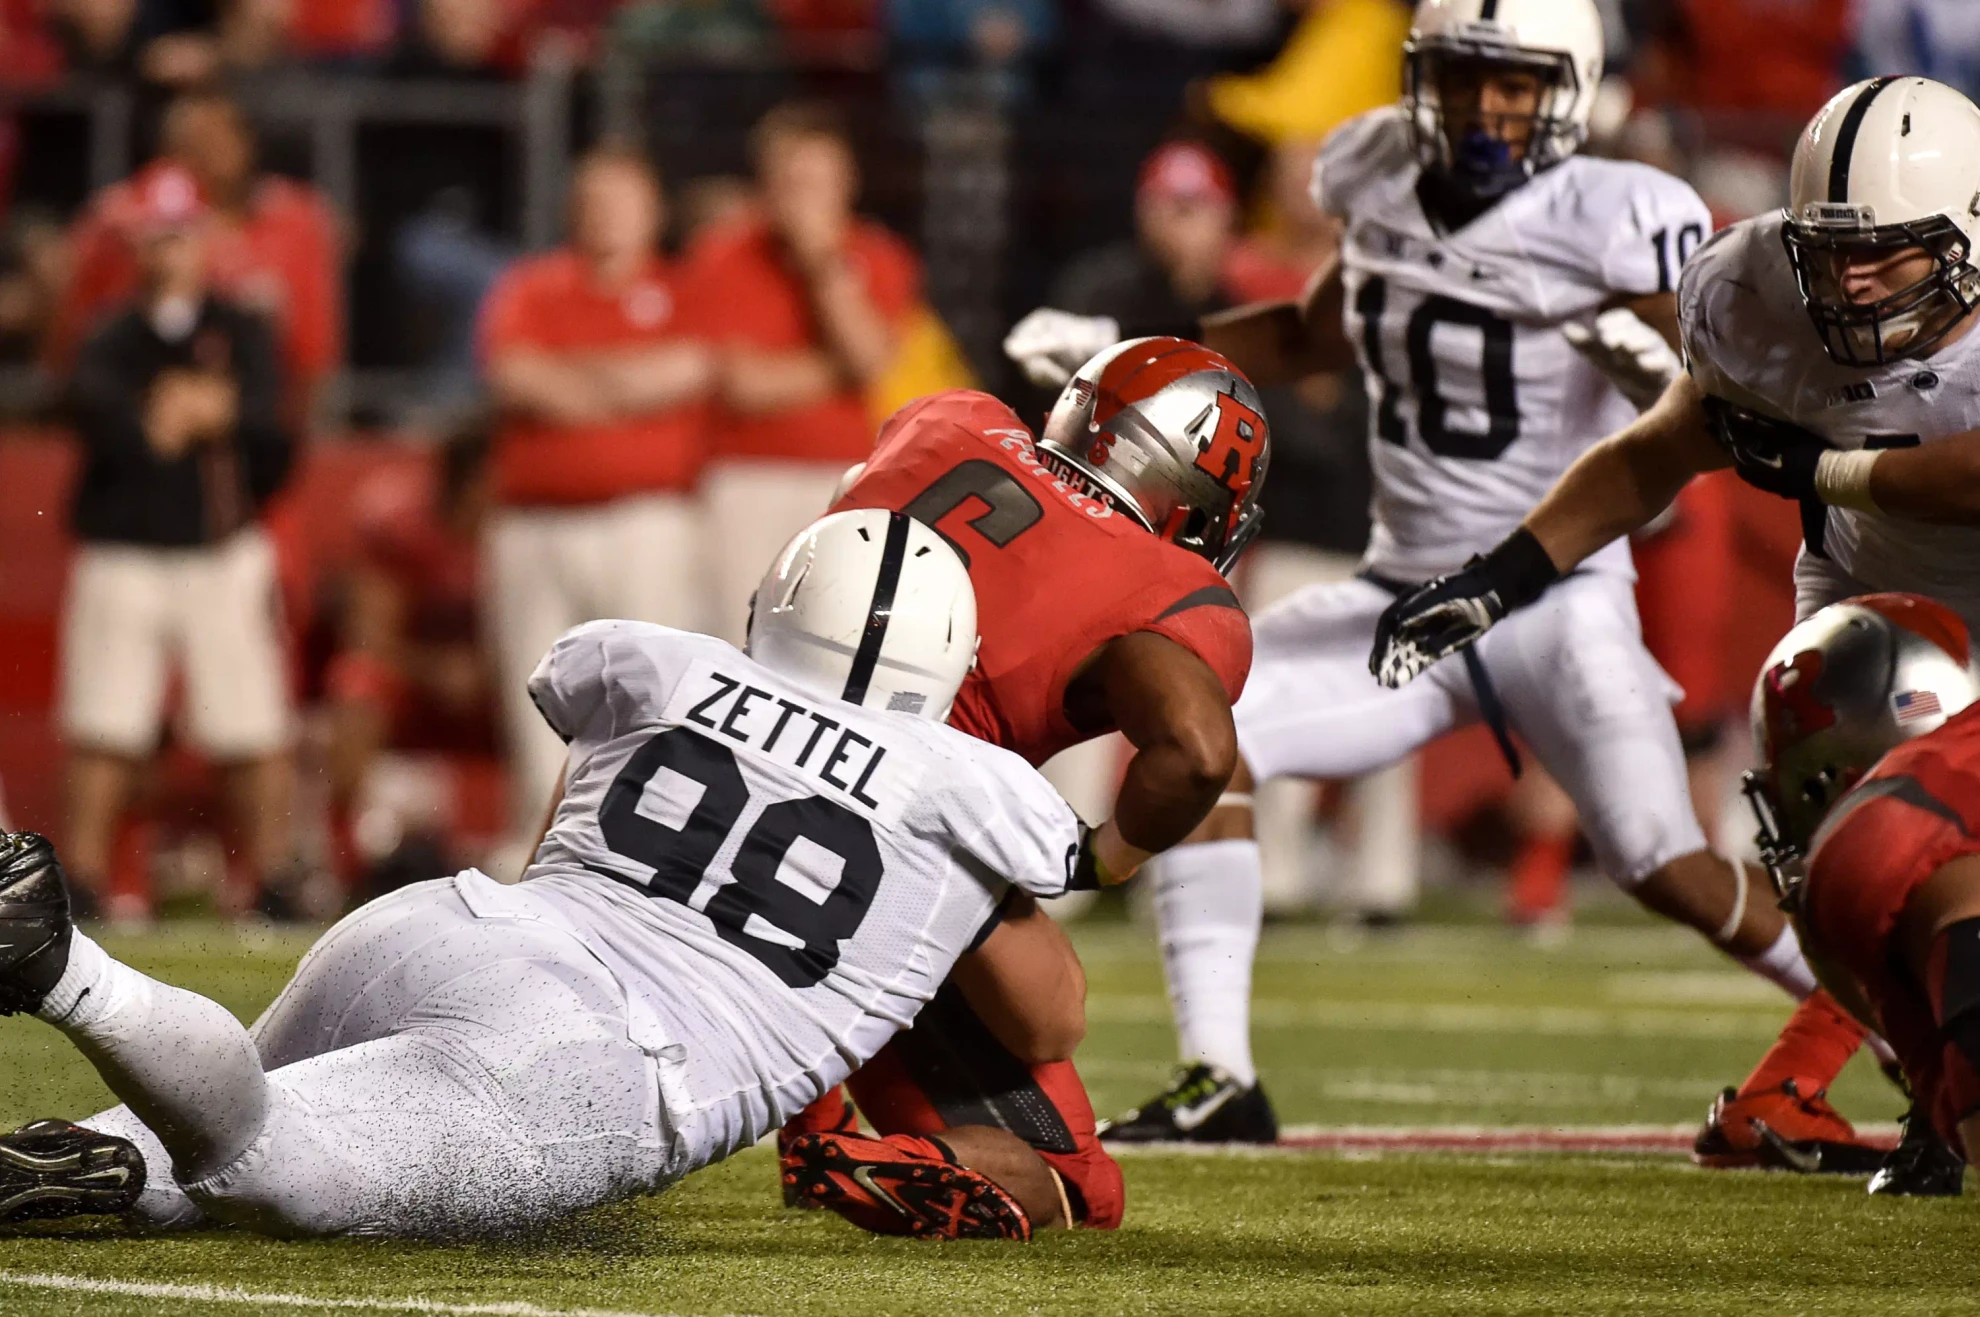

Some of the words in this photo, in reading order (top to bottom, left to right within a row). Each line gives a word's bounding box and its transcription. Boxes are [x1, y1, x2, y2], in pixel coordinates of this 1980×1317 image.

[1356, 274, 1519, 461] 10
[983, 429, 1116, 518] PEOS
[1037, 450, 1115, 506] NIGHTS
[1088, 431, 1116, 466] 6
[1193, 390, 1268, 494] R
[686, 672, 888, 810] ZETTEL
[584, 725, 885, 988] 98
